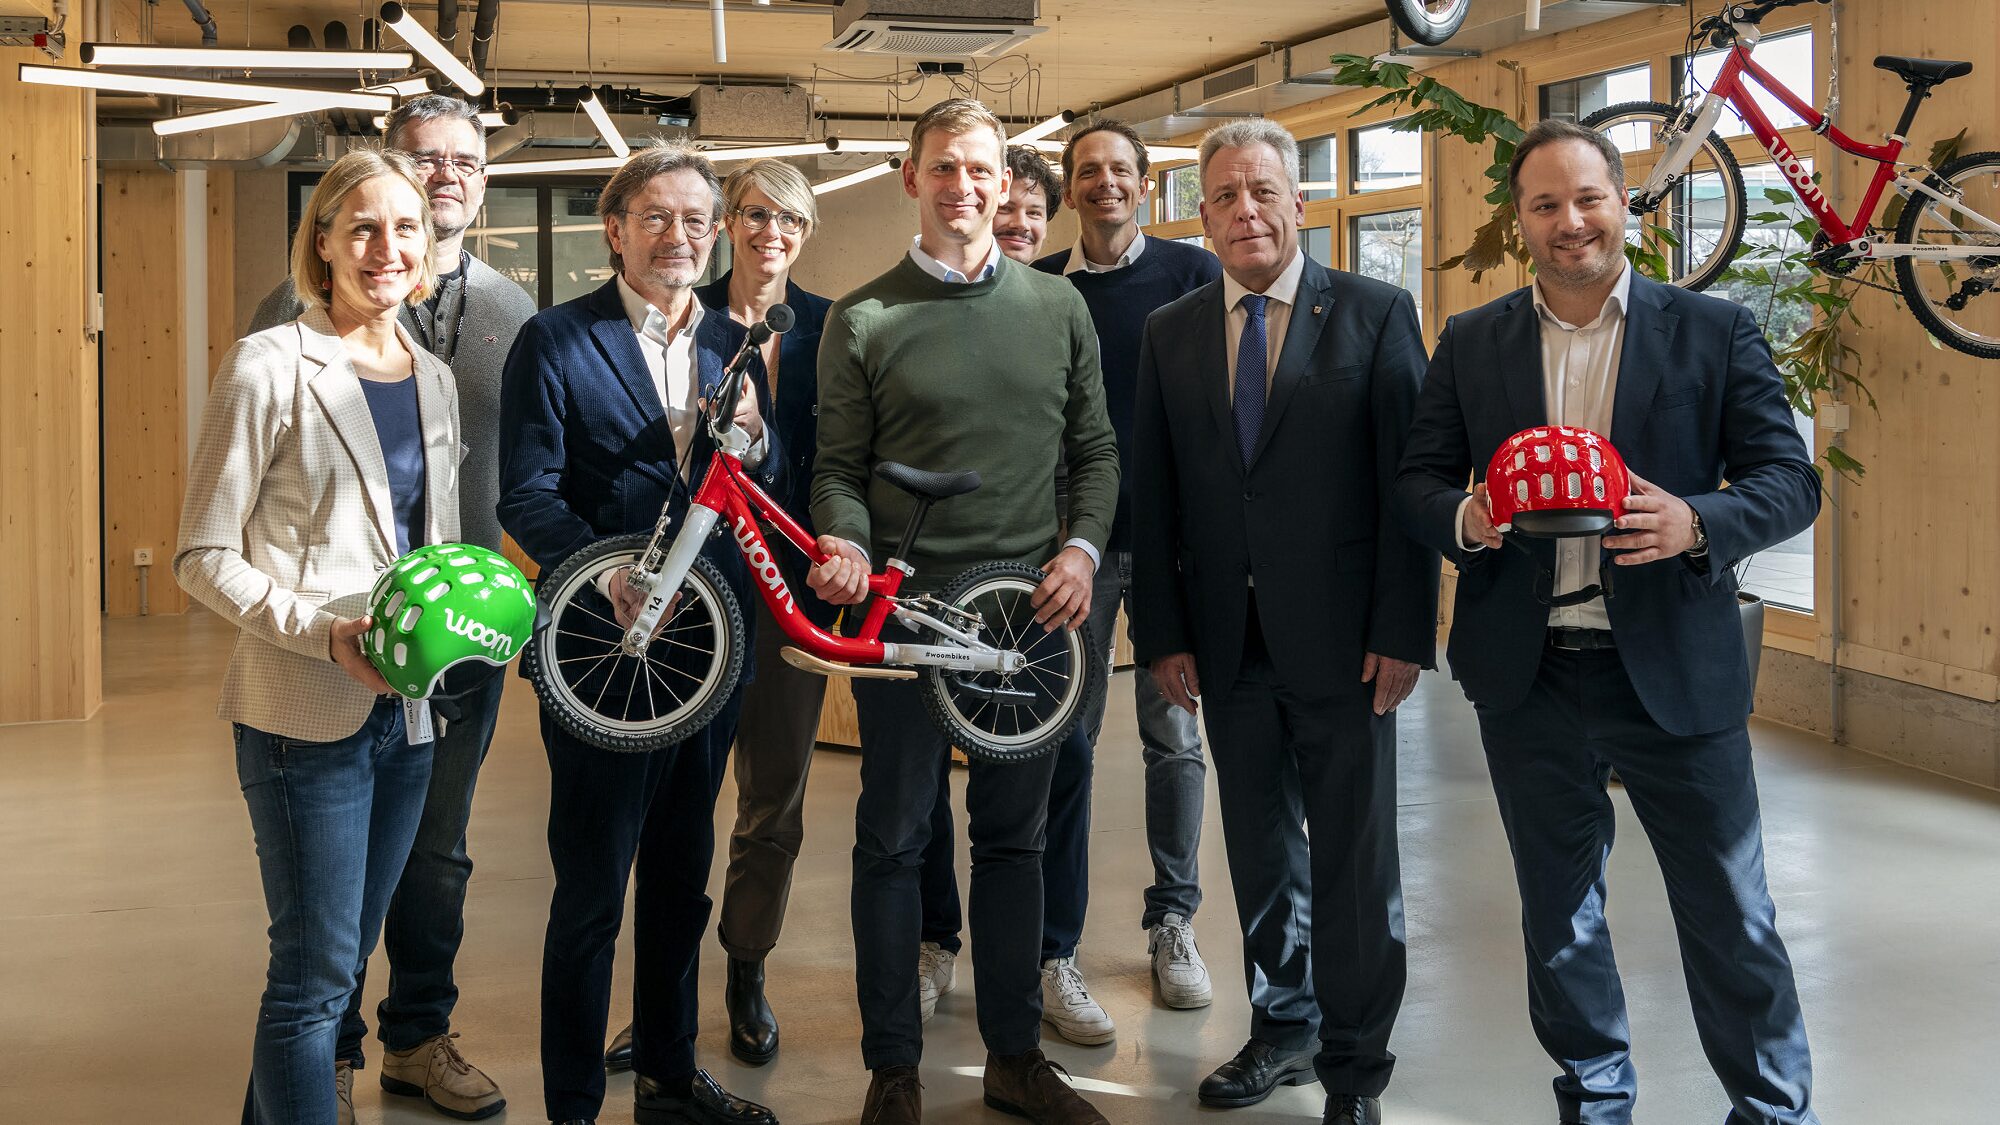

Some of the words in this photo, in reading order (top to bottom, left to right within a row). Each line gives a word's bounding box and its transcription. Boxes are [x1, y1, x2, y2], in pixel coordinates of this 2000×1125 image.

[1664, 173, 1675, 185] 20
[1768, 136, 1829, 213] woom
[733, 516, 794, 615] woom
[648, 596, 664, 611] 14
[444, 607, 513, 656] woom
[925, 651, 970, 661] #woombikes
